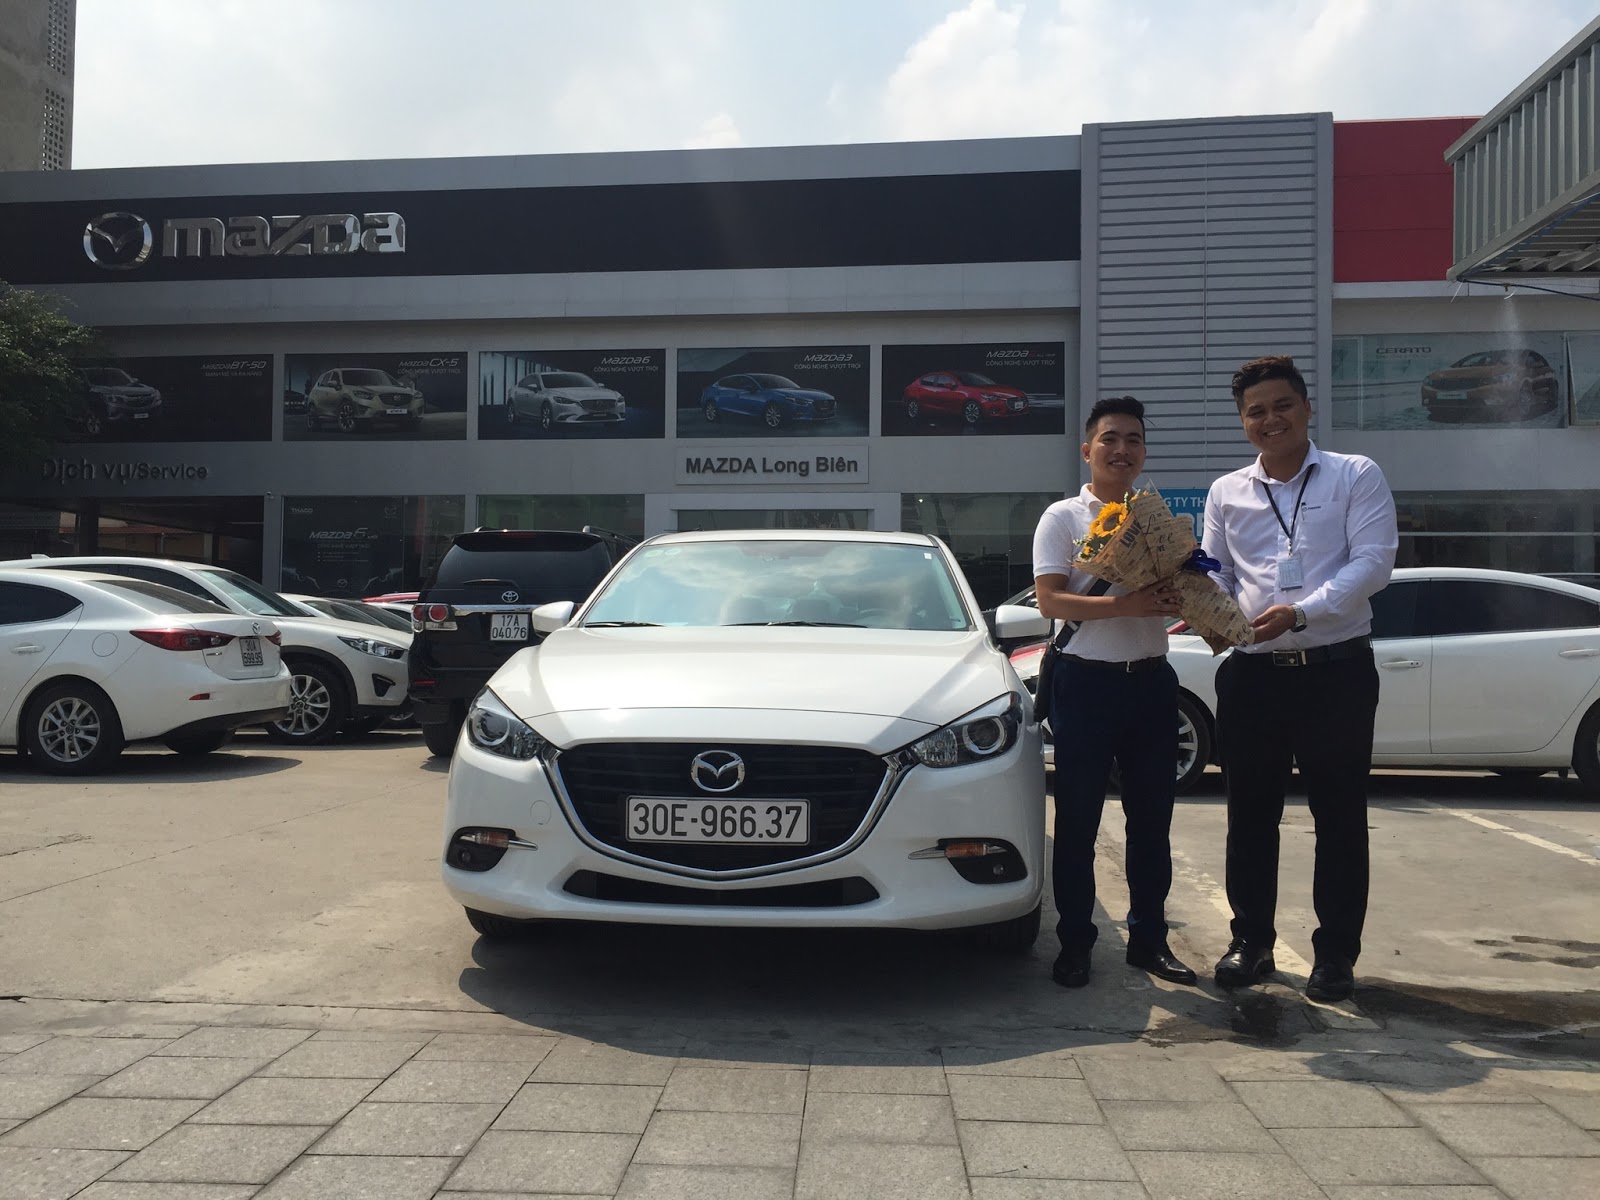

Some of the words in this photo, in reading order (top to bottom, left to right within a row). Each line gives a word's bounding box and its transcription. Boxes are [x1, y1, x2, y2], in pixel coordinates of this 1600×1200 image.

[162, 212, 406, 259] mazda
[1376, 346, 1432, 355] CERATO
[686, 457, 757, 474] MAZDA
[762, 457, 809, 477] Long
[815, 456, 858, 473] Biên
[1173, 497, 1189, 507] TY
[1190, 497, 1206, 507] TH
[502, 614, 519, 627] 17A
[492, 626, 527, 639] 040.76
[632, 802, 803, 840] 30E-966.37
